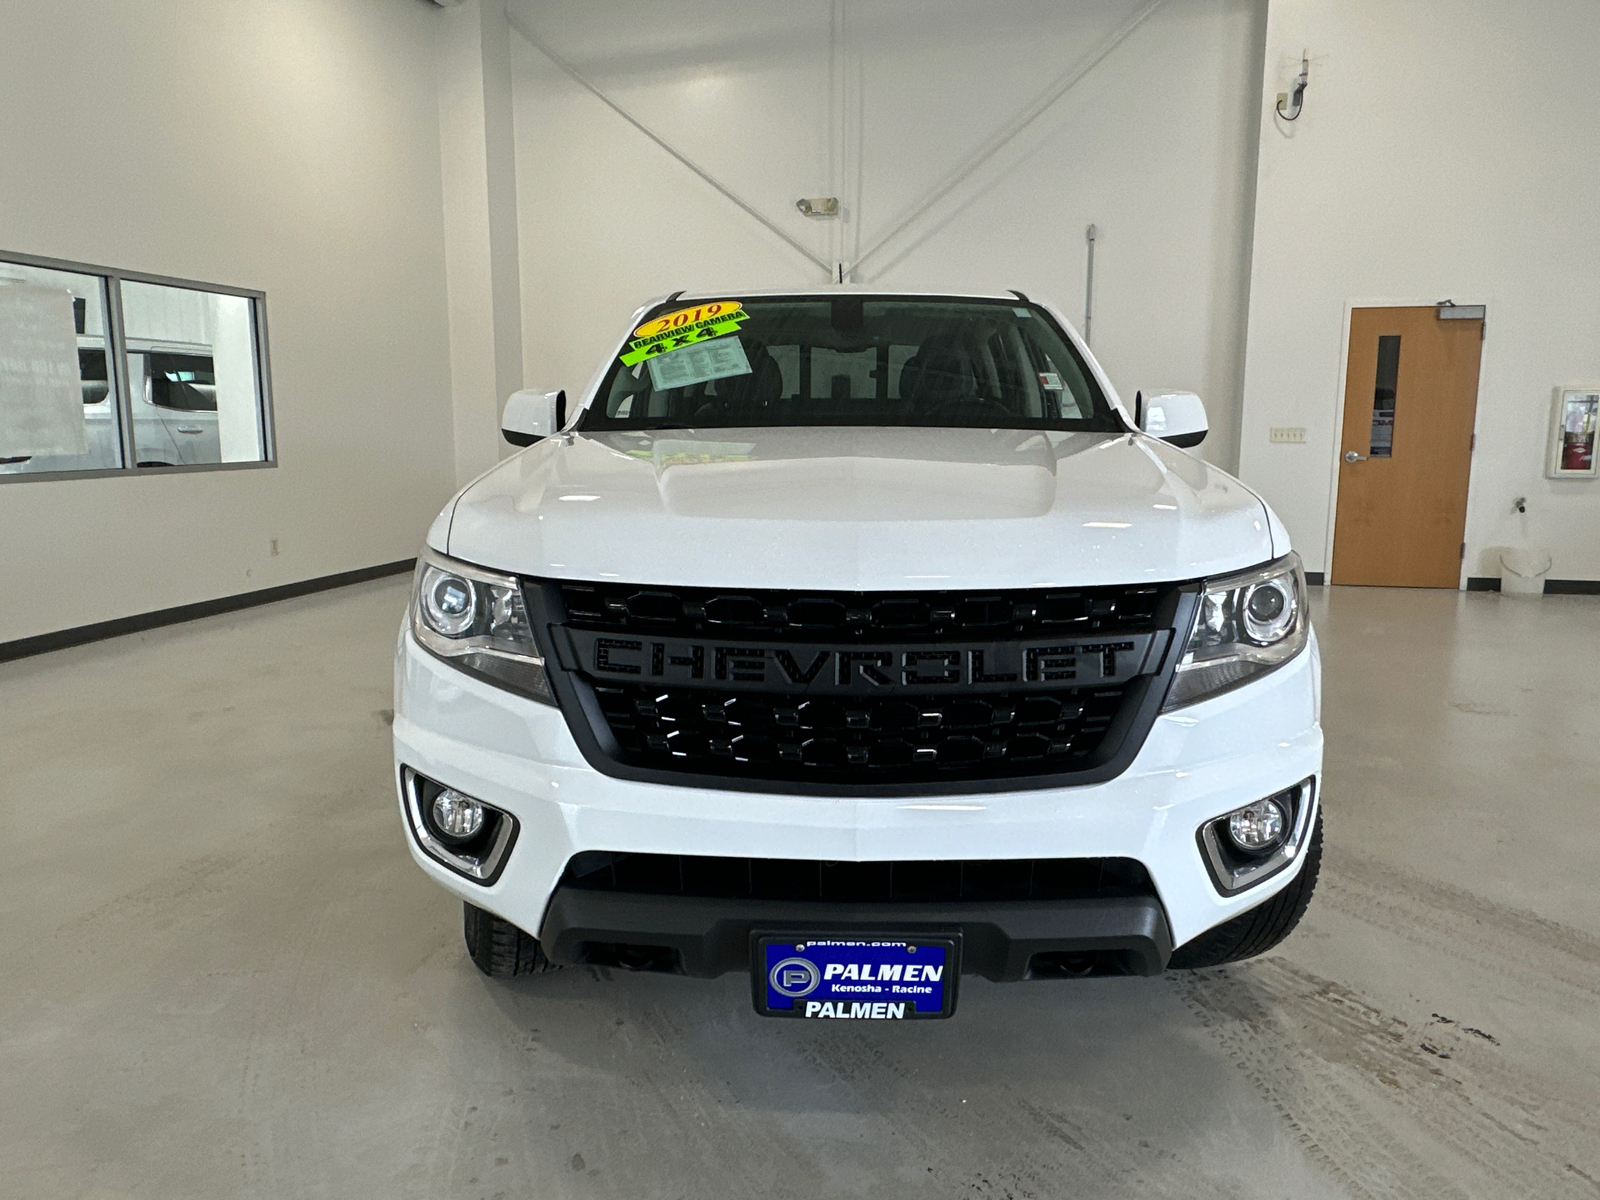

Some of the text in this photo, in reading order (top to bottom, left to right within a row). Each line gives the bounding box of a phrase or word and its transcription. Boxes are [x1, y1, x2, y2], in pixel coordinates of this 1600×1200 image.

[634, 311, 743, 349] REARVIEW CAMERA
[657, 305, 722, 333] 2019
[594, 638, 1134, 686] CHEVROLET
[823, 963, 943, 982] PALMEN
[831, 983, 882, 993] Kenosha
[892, 985, 933, 994] Racine
[805, 1001, 906, 1019] PALMEN
